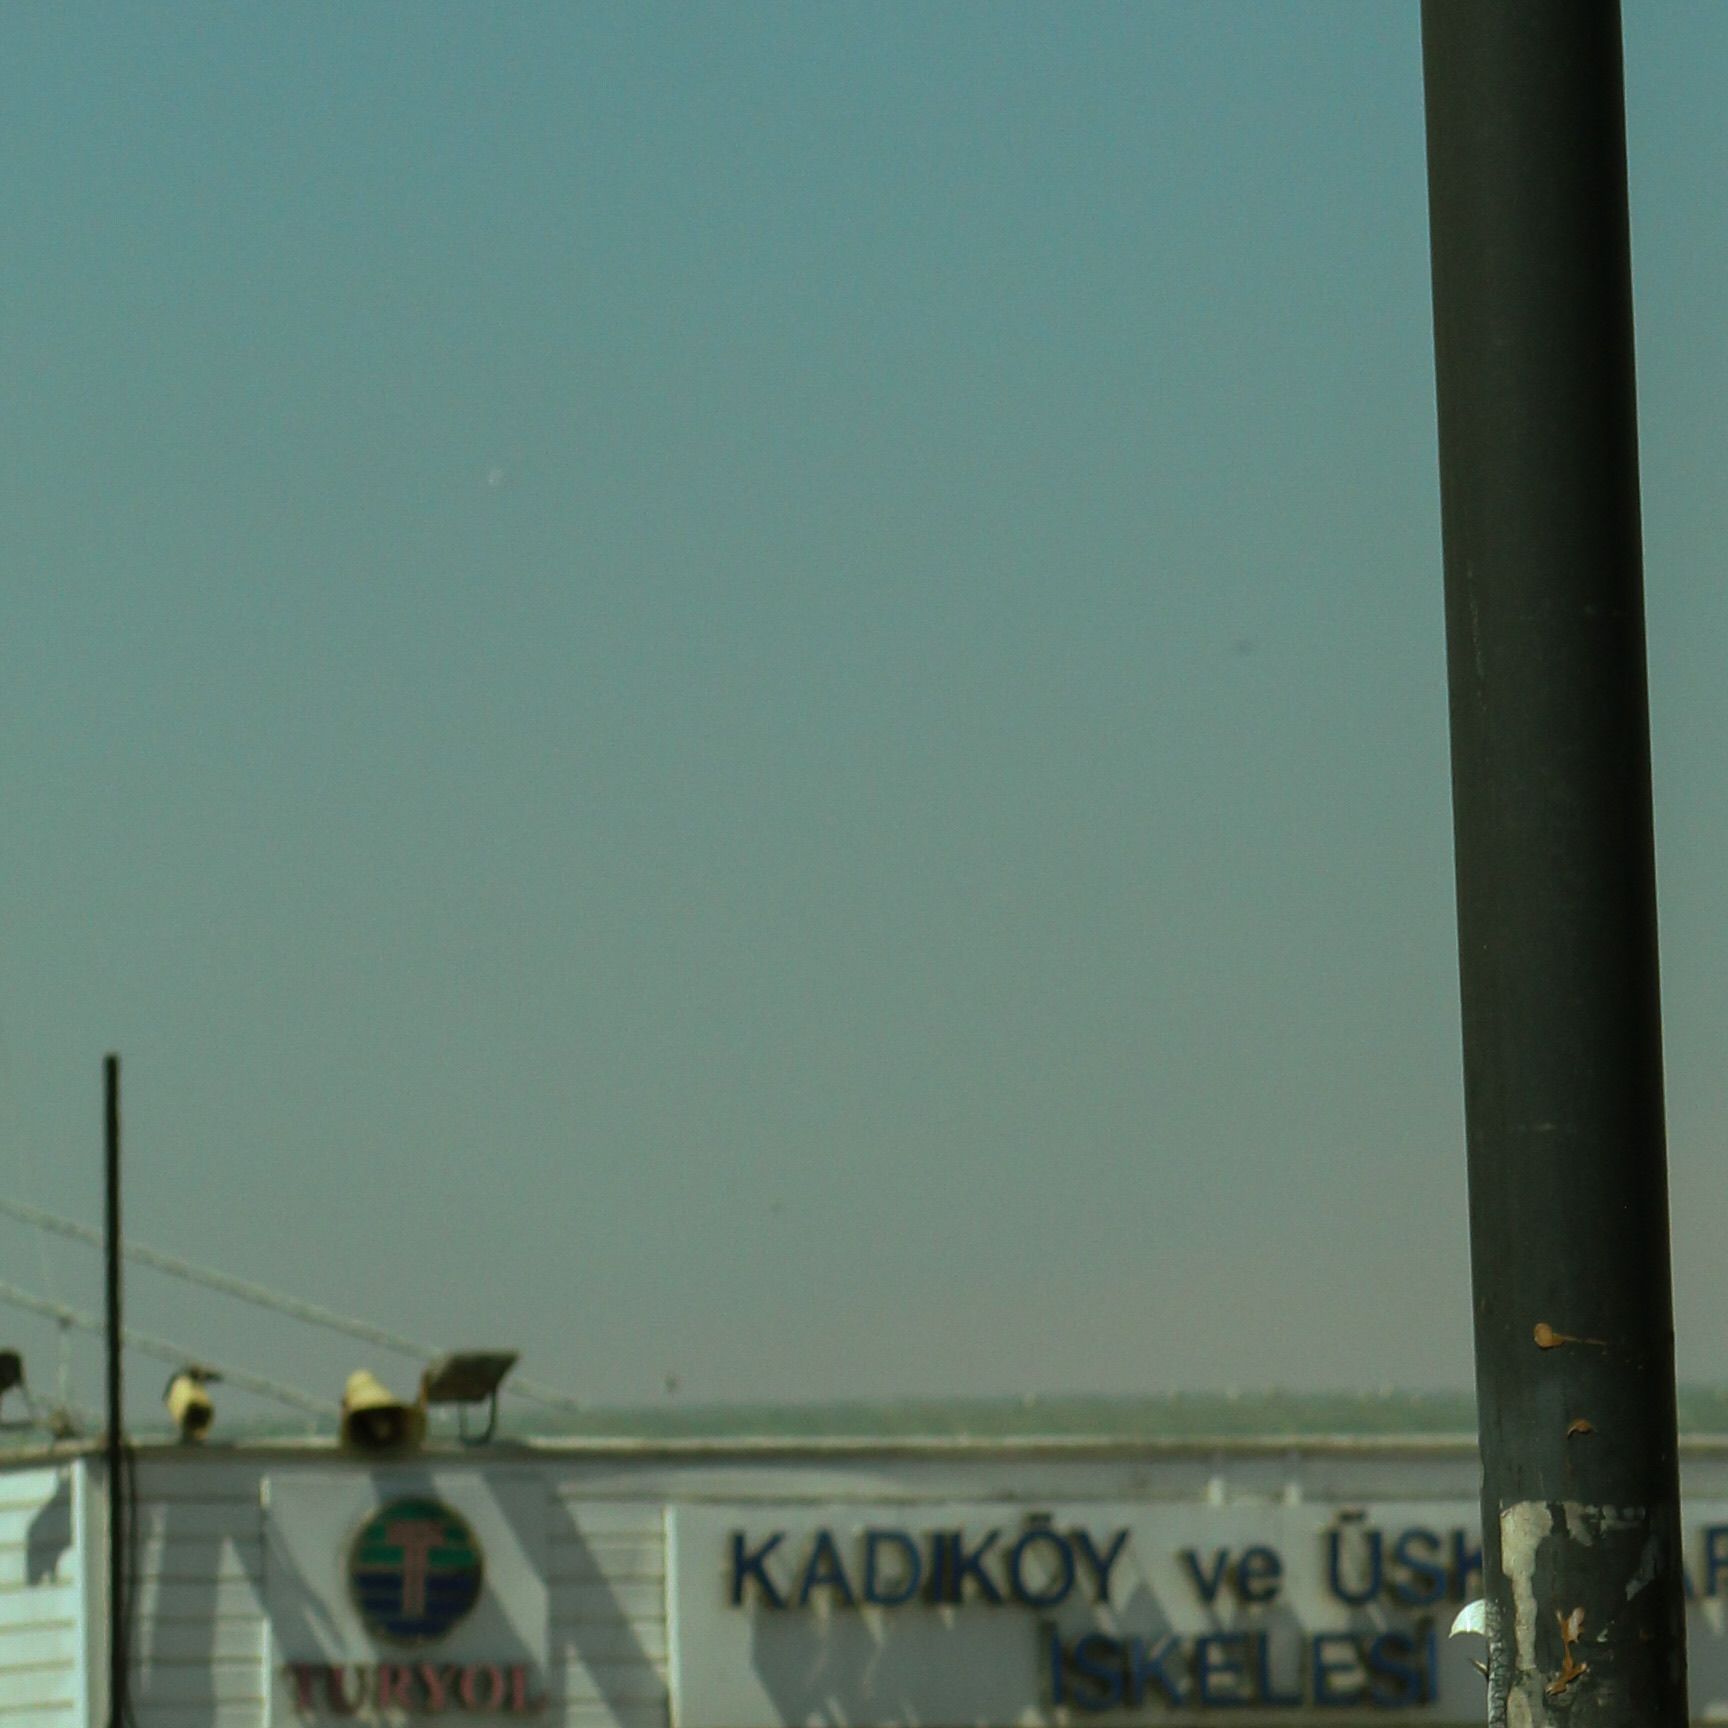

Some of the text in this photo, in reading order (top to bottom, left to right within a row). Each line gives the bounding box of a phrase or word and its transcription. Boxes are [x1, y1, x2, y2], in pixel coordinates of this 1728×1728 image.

[729, 1513, 1131, 1610] KADIKÖY
[1181, 1546, 1282, 1602] ve
[284, 1660, 549, 1716] TURYOL
[1040, 1621, 1438, 1711] İSKELESİ
